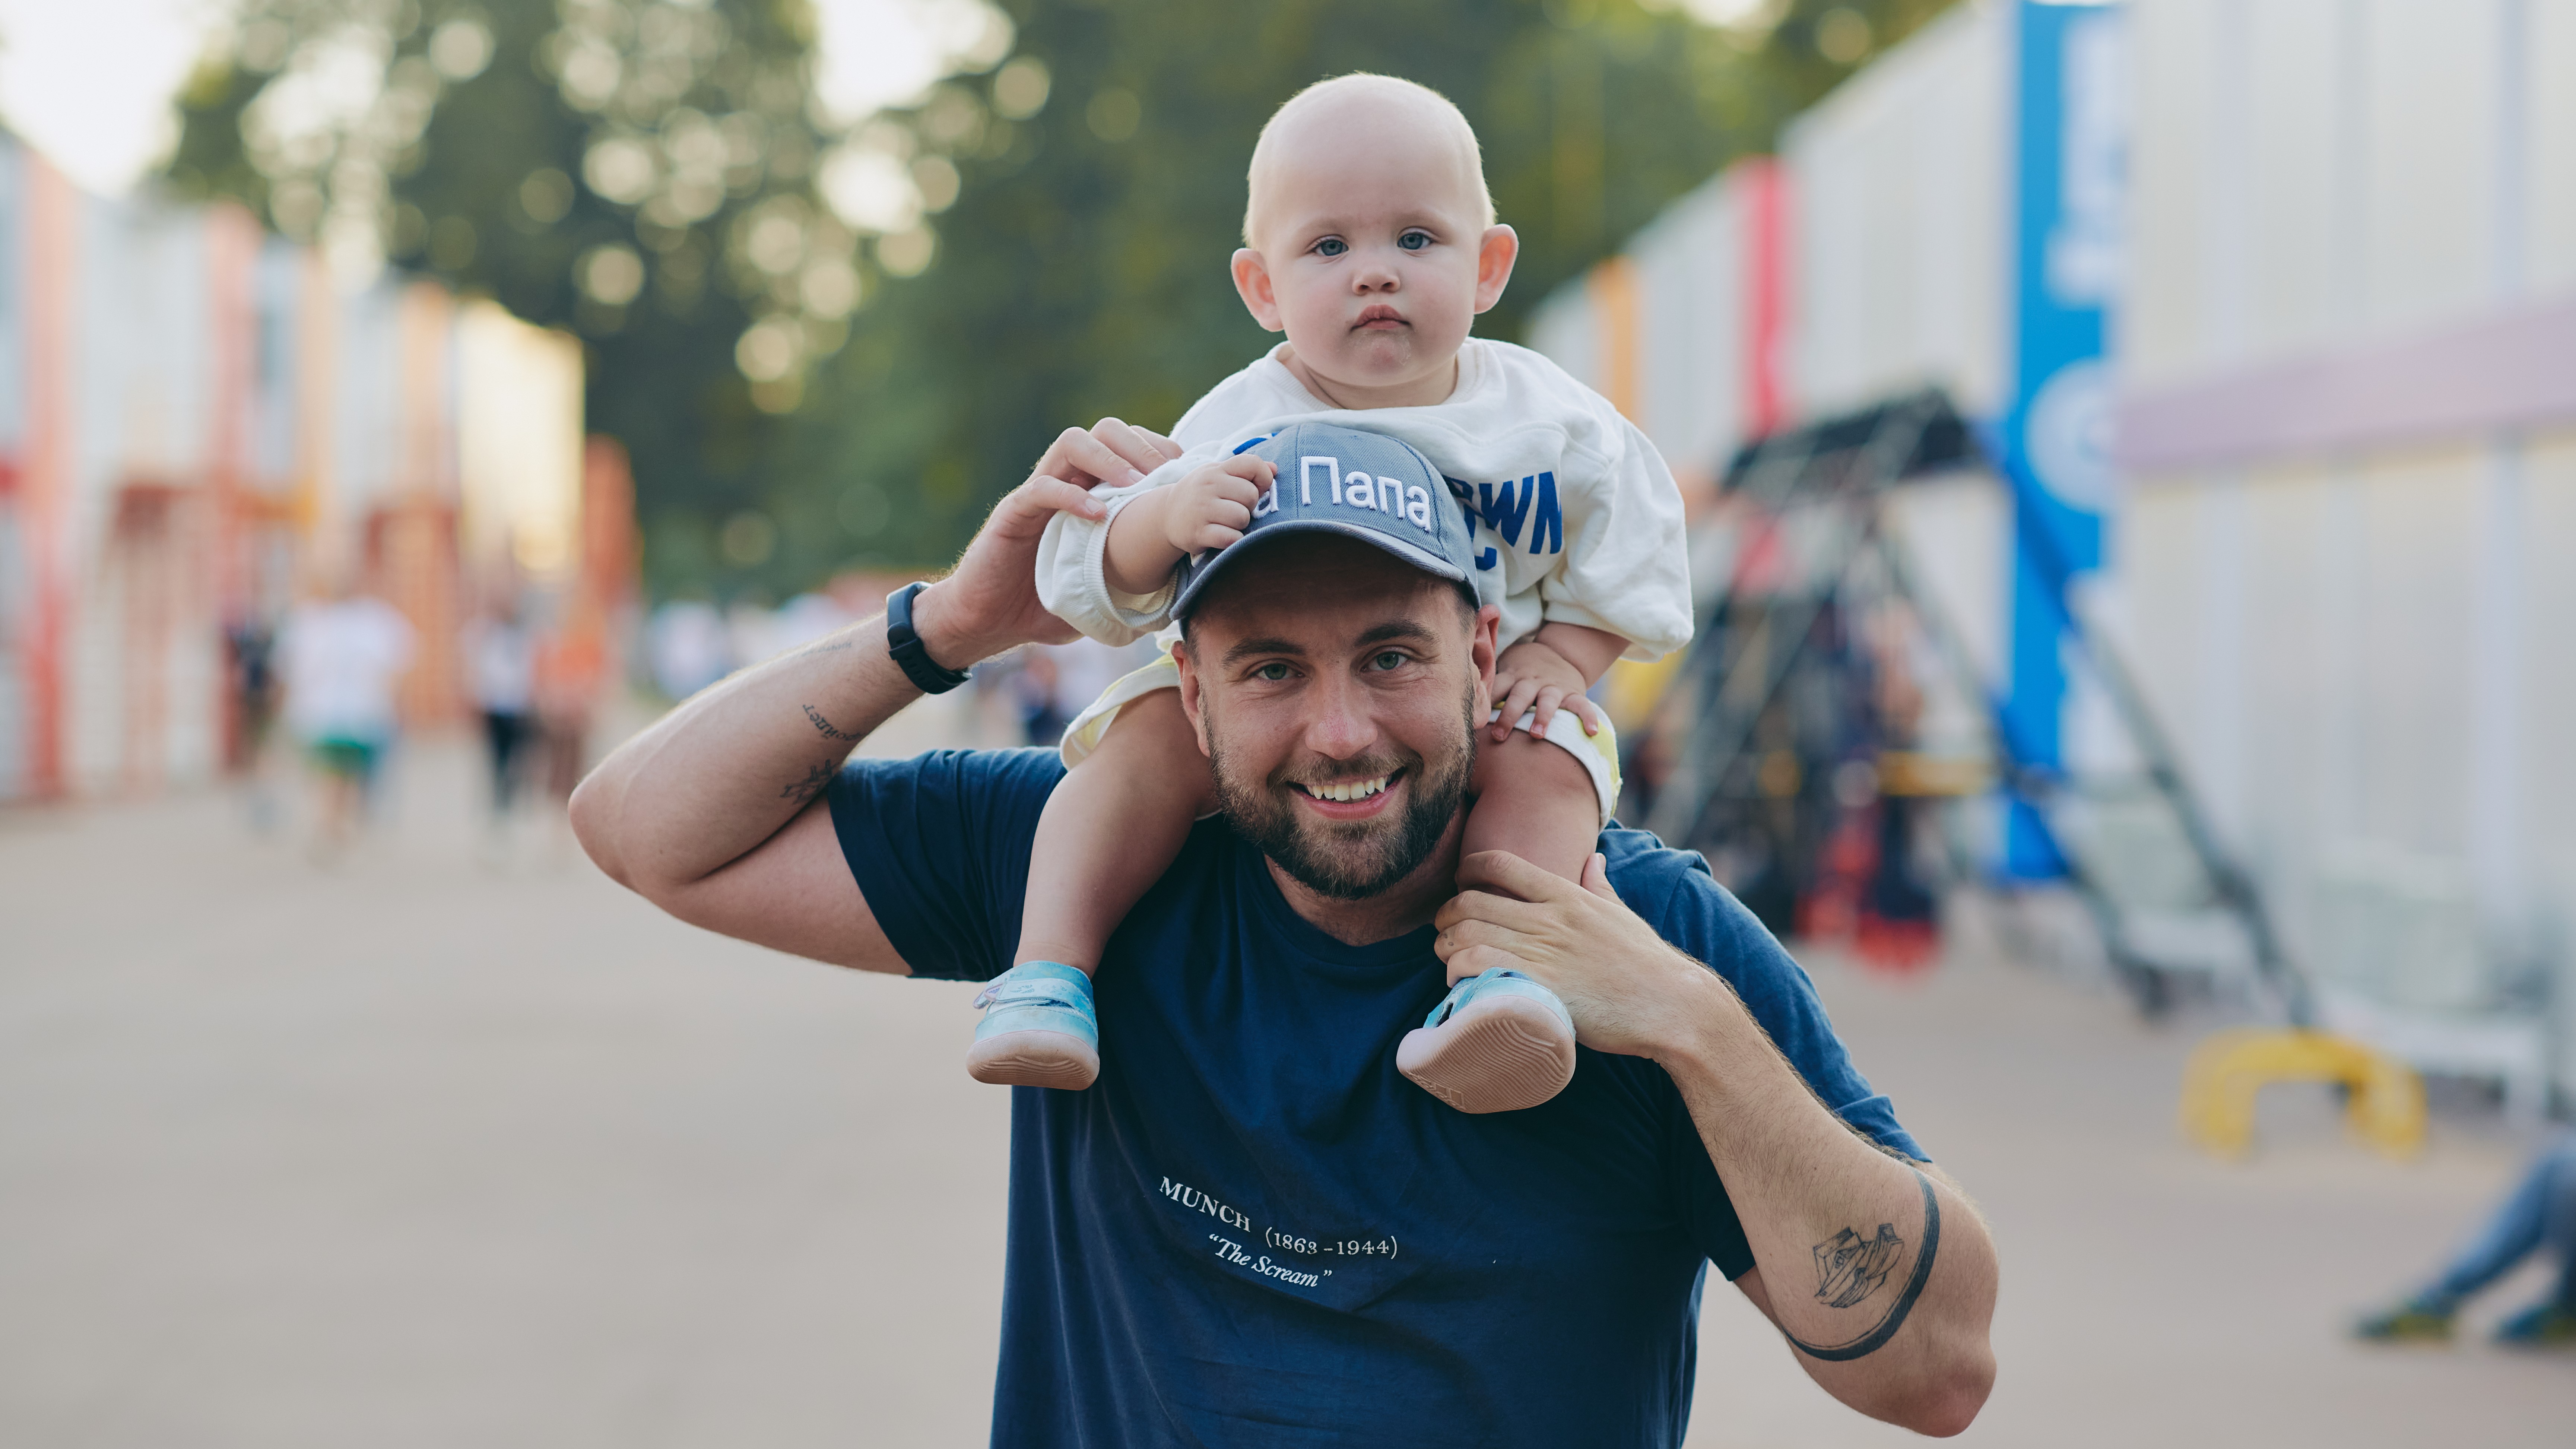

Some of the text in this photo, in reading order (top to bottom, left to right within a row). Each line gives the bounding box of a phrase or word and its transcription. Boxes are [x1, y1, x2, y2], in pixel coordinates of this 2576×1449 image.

[1300, 456, 1433, 533] Папа
[1159, 1176, 1251, 1233] MUNCH
[1209, 1233, 1251, 1266] “The
